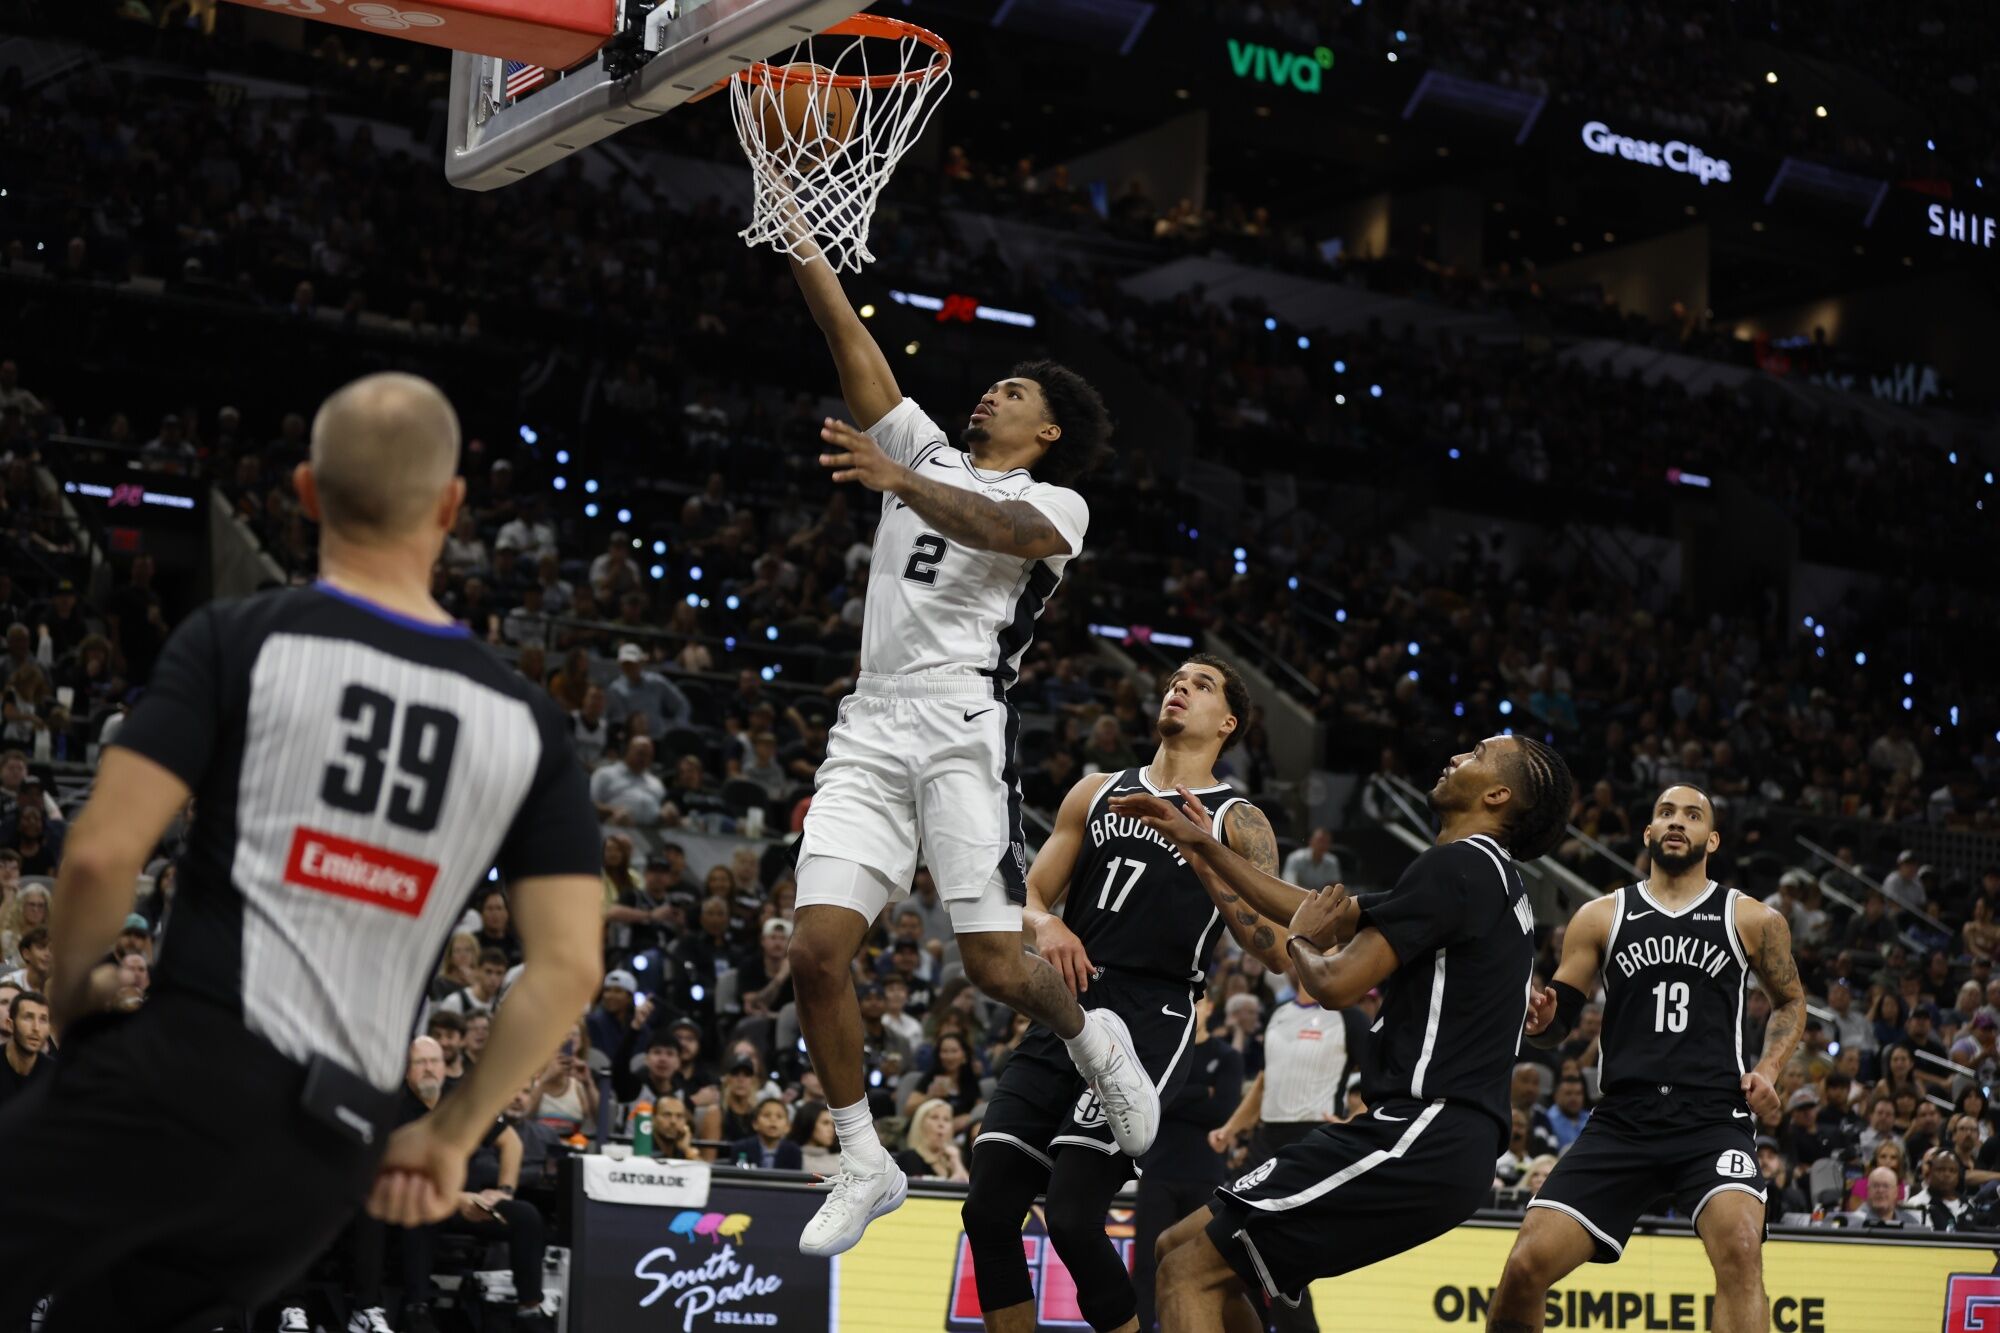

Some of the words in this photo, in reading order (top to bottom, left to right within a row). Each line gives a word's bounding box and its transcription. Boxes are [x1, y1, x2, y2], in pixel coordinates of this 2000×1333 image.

[1227, 39, 1321, 93] viva
[1582, 121, 1663, 167] Great
[1663, 141, 1732, 186] Clips
[901, 532, 949, 587] 2
[320, 682, 460, 832] 39
[300, 840, 421, 902] Emirates
[1097, 856, 1147, 913] 17
[1615, 935, 1731, 979] BROOKLYN
[1652, 981, 1690, 1033] 13
[609, 1172, 685, 1188] GATORADE
[634, 1243, 741, 1308] South
[674, 1264, 782, 1333] Padre
[714, 1311, 778, 1326] ISLAND
[1544, 1288, 1695, 1332] SIMPLE
